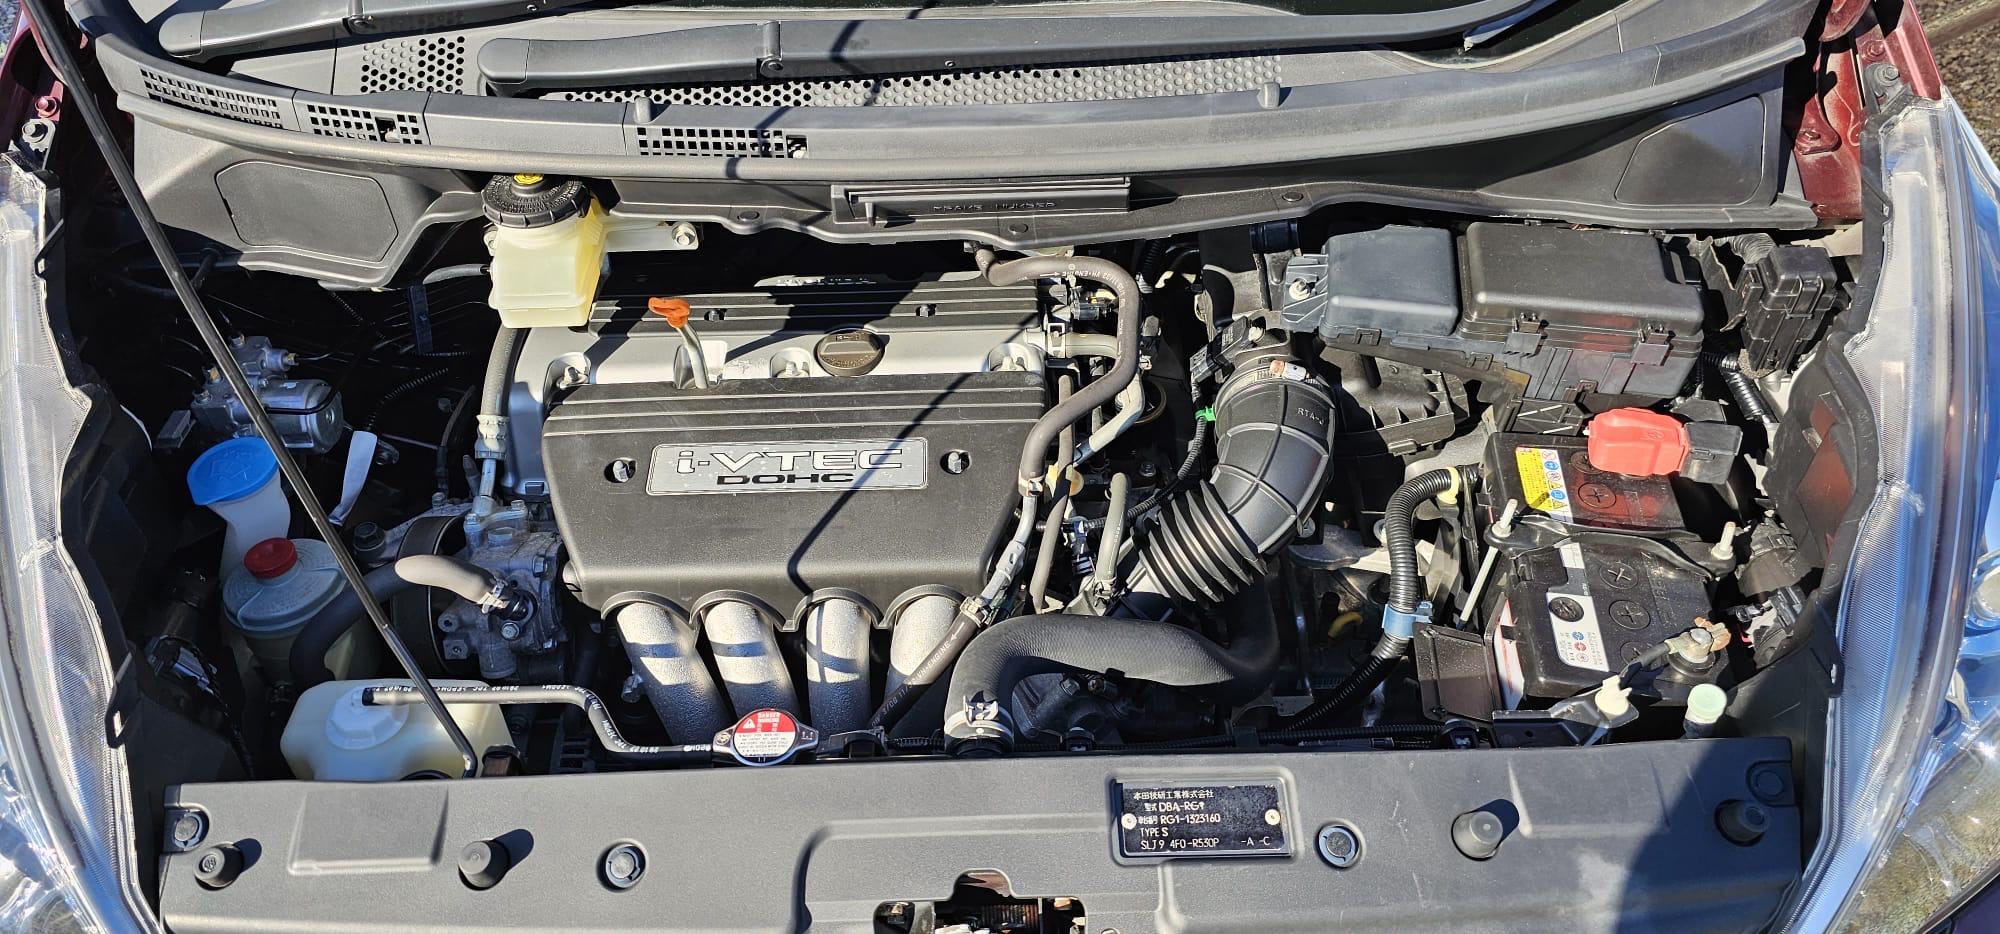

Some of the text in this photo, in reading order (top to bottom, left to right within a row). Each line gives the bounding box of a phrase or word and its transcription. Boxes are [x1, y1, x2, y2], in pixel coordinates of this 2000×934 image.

[676, 449, 902, 474] i-VTEC
[716, 473, 854, 485] DOHC
[1133, 790, 1214, 800] 本田技研工業株式会社
[1160, 813, 1221, 824] RG1-1323160
[1140, 827, 1169, 837] TYPE S
